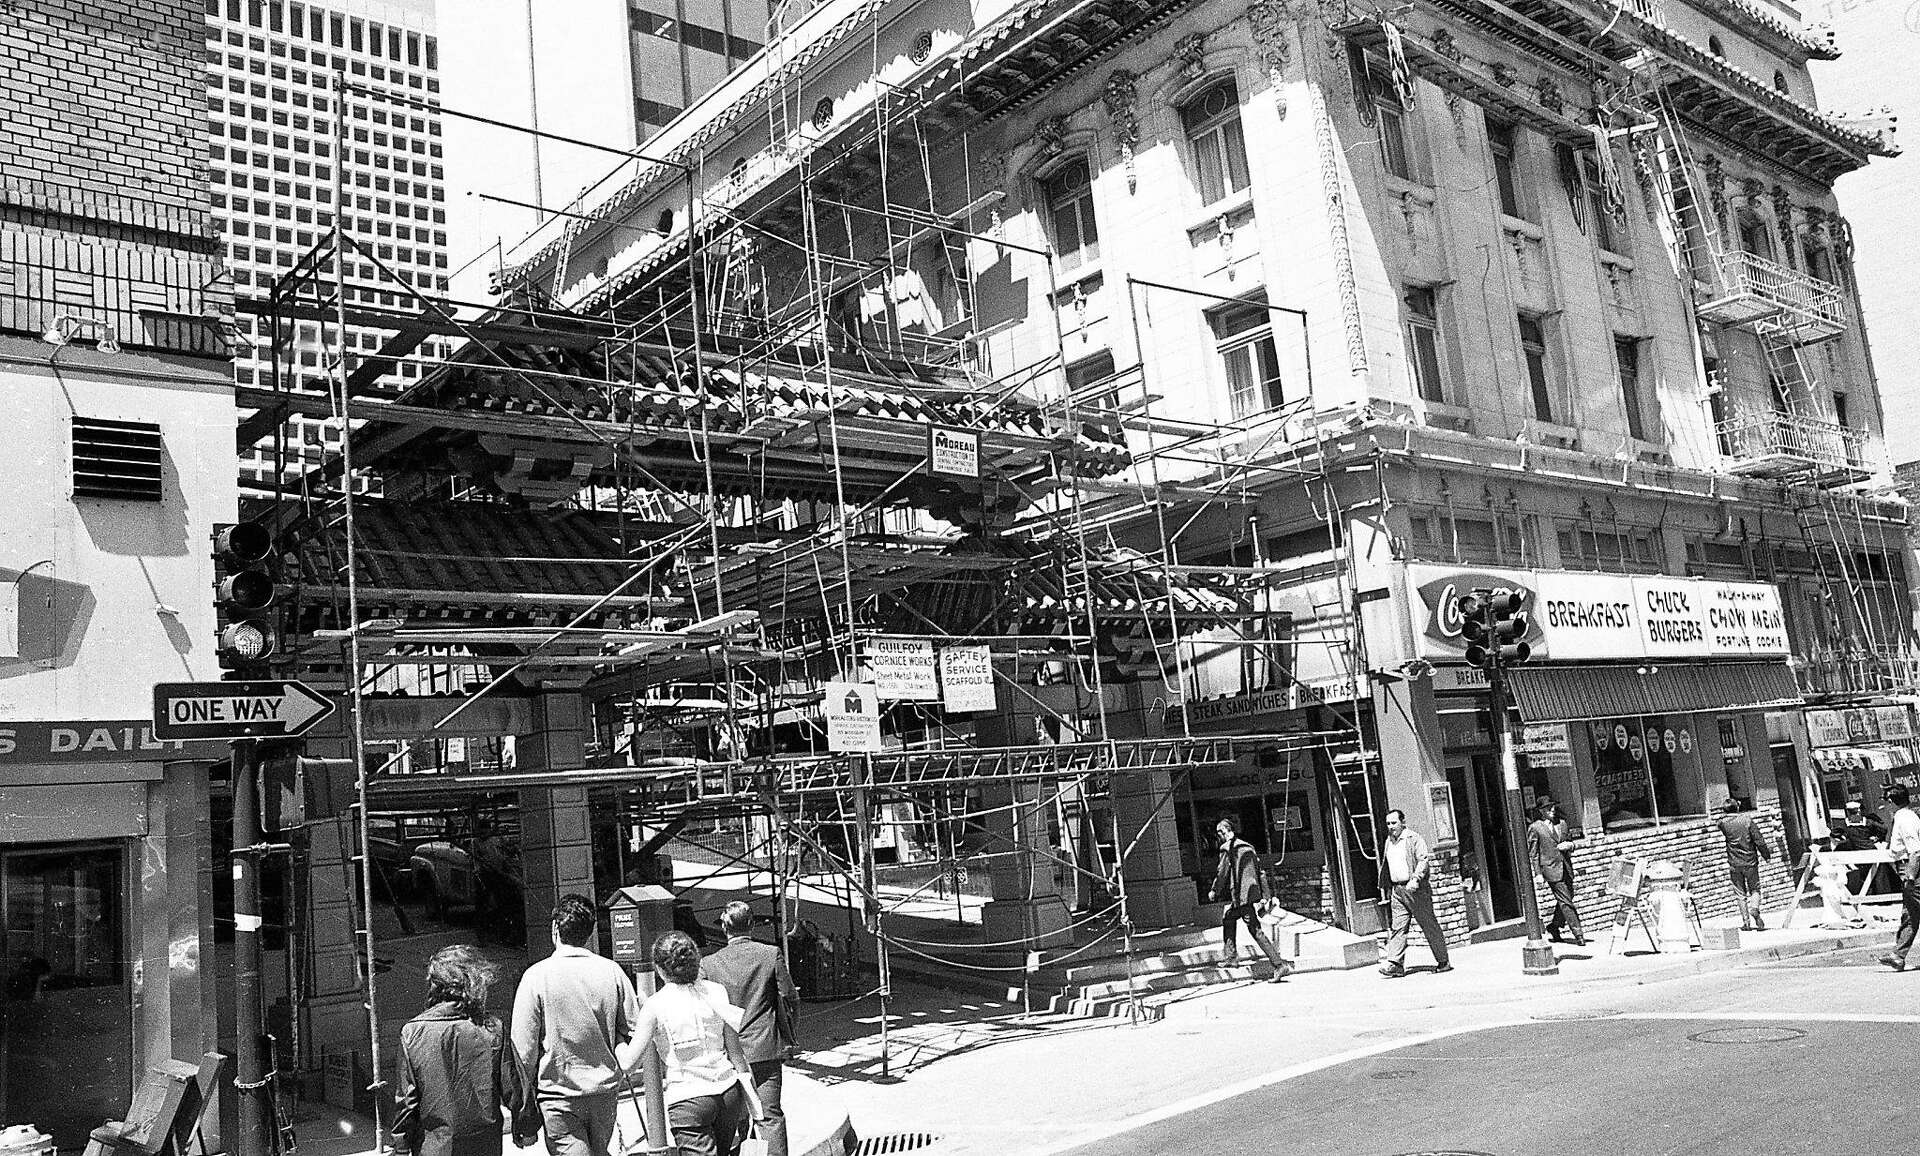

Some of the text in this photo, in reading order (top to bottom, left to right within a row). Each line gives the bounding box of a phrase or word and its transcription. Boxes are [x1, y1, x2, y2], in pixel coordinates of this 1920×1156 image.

[935, 436, 975, 452] MOREAU
[1647, 590, 1690, 613] CHUCK
[1547, 600, 1631, 628] BREAKFAST
[1709, 608, 1781, 629] CHOW MEIN
[1647, 619, 1704, 643] BURGERS
[878, 642, 923, 654] GUILFOY
[1716, 635, 1751, 647] FORTUNE
[874, 655, 933, 667] CORNICE WORKS
[945, 650, 987, 665] SAFTEY
[946, 664, 987, 675] SERVICE
[946, 676, 982, 686] SCAFFOLD
[1193, 703, 1223, 720] STEAK
[1226, 692, 1287, 714] SANDWICHES
[1299, 680, 1359, 703] BREAKFAST
[174, 697, 283, 723] ONE WAY
[50, 727, 184, 752] DAIL
